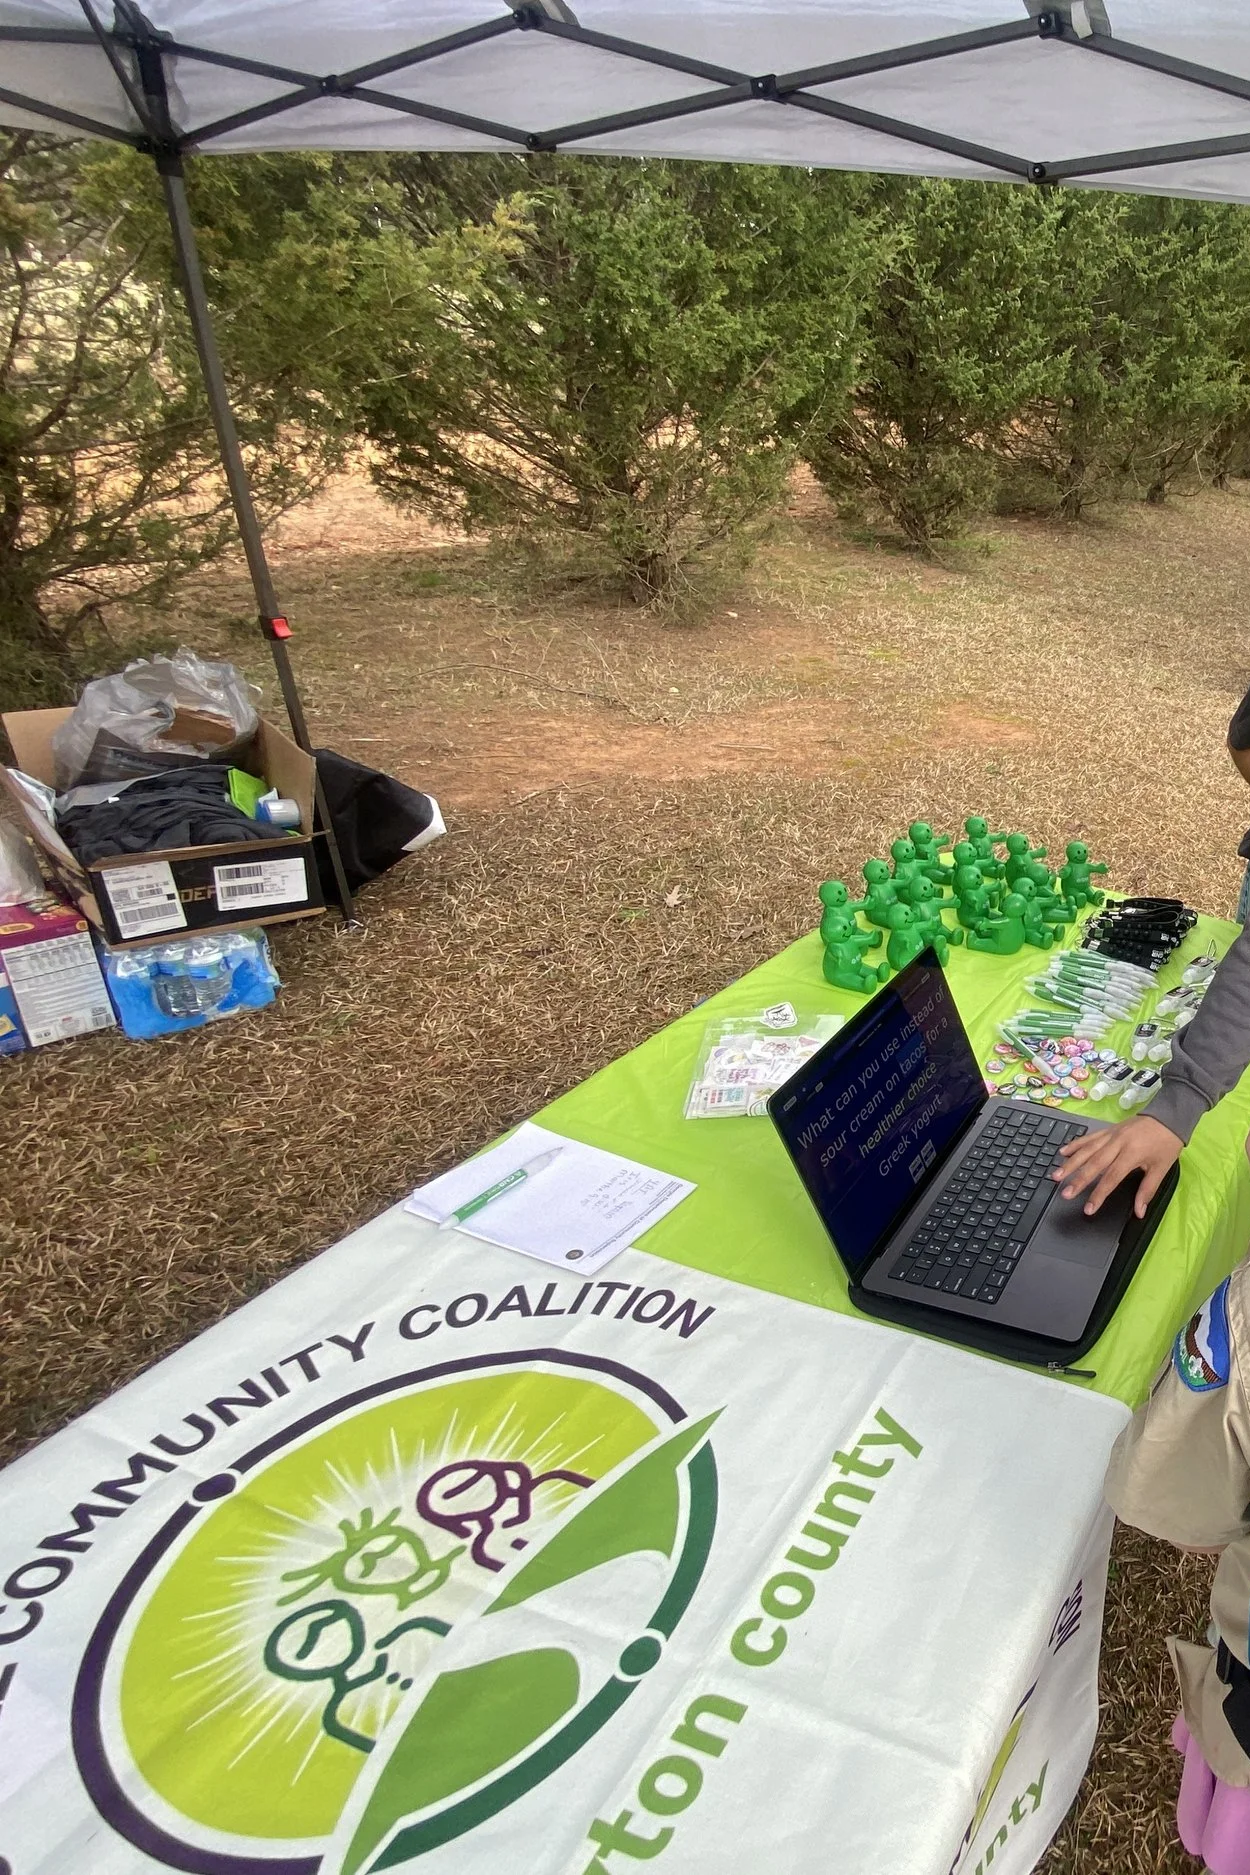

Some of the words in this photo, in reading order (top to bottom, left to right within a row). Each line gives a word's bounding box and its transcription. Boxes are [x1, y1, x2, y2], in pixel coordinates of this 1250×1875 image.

[797, 1108, 835, 1149] What
[836, 1084, 857, 1112] can
[858, 1059, 880, 1089] you
[881, 1037, 900, 1062] use
[900, 999, 935, 1041] instead
[936, 984, 946, 1007] of
[820, 1129, 846, 1168] sour
[850, 1090, 885, 1133] cream
[886, 1073, 900, 1092] on
[900, 1042, 926, 1074] tacos
[926, 1024, 940, 1046] for
[942, 1017, 948, 1028] a
[858, 1097, 906, 1158] healthier
[908, 1062, 937, 1100] choice
[879, 1135, 911, 1176] Greek
[911, 1093, 942, 1140] yogurt
[0, 1321, 375, 1645] COMMUNITY
[398, 1281, 717, 1340] COALITION
[583, 1693, 748, 1875] ton
[730, 1406, 924, 1667] county
[975, 1758, 1050, 1875] nty
